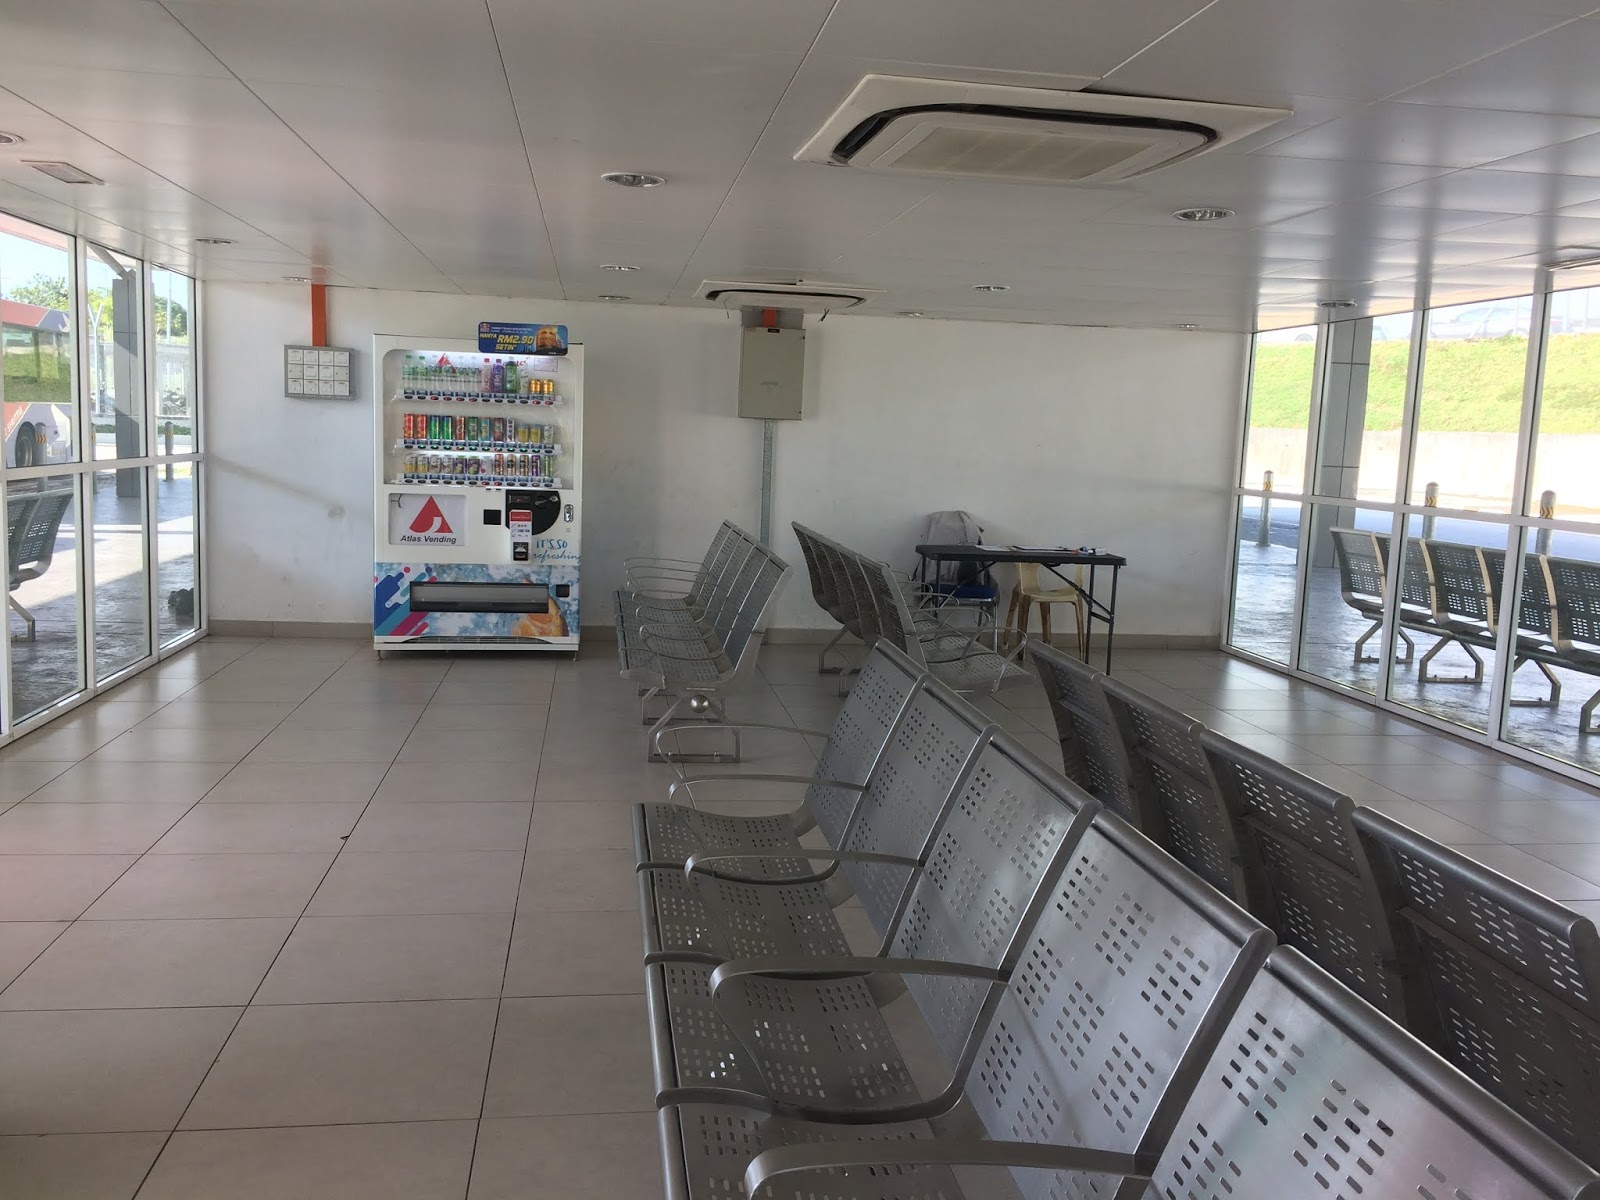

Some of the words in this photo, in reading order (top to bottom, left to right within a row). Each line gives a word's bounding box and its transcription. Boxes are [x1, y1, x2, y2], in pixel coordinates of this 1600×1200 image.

[497, 335, 533, 344] RM2.90
[400, 535, 422, 543] Atlas
[424, 536, 457, 545] Vending
[556, 539, 568, 550] SO
